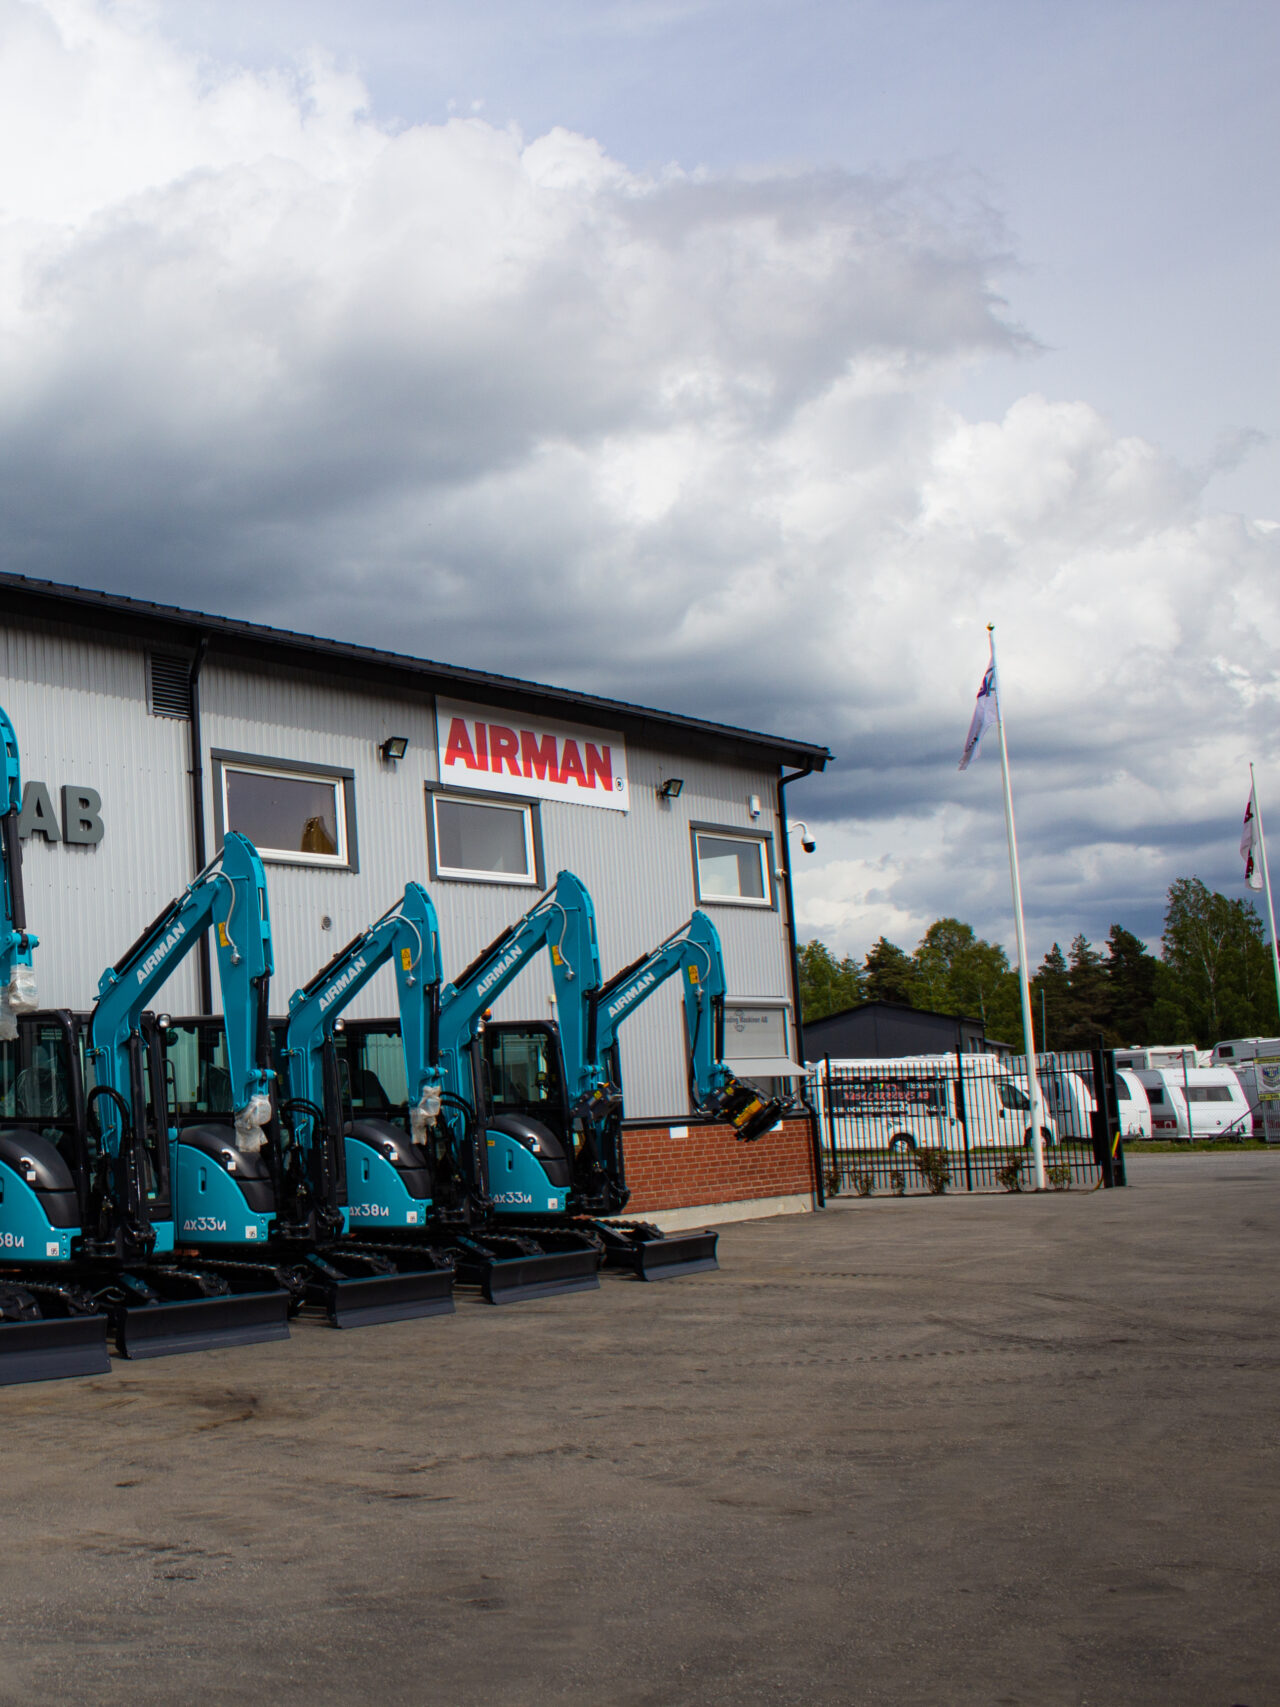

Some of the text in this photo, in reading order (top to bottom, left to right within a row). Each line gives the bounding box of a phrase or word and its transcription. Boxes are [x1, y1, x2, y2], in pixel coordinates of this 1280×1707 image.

[444, 717, 613, 791] AIRMAN
[18, 780, 105, 846] AB
[136, 921, 187, 985] AIRMAN
[476, 944, 523, 998] AIRMAN
[319, 956, 367, 1012] AIRMAN
[607, 972, 656, 1019] AIRMAN
